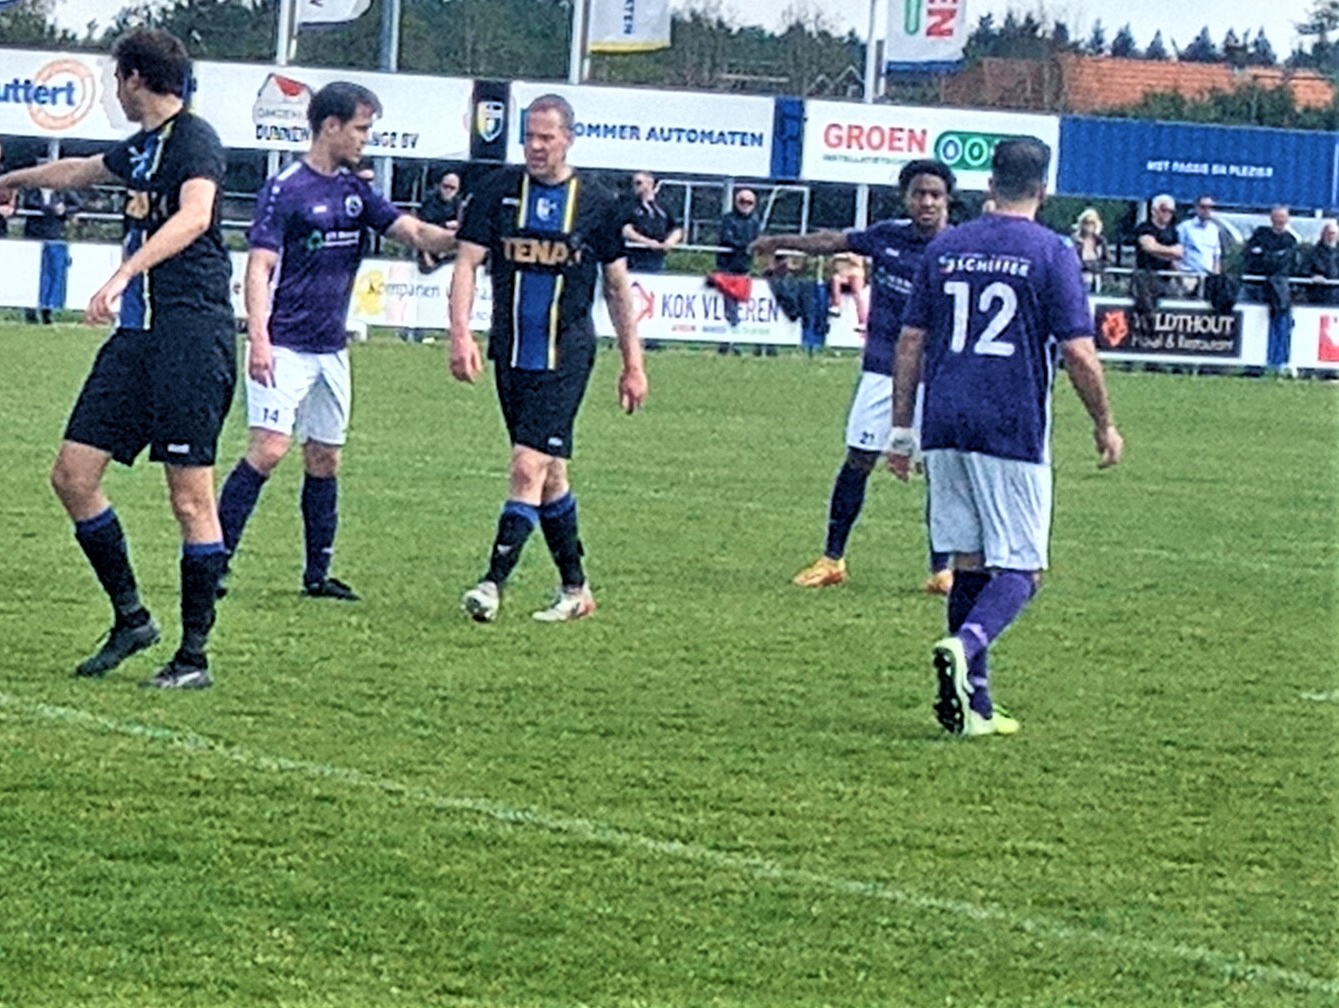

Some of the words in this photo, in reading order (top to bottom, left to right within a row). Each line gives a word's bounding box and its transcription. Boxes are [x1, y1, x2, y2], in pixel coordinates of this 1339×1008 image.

[645, 126, 765, 148] AUTOMATEN
[823, 123, 928, 154] GROEN
[662, 294, 696, 320] KOK
[702, 295, 779, 323] VLREN
[944, 281, 1017, 357] 12
[261, 407, 279, 425] 14
